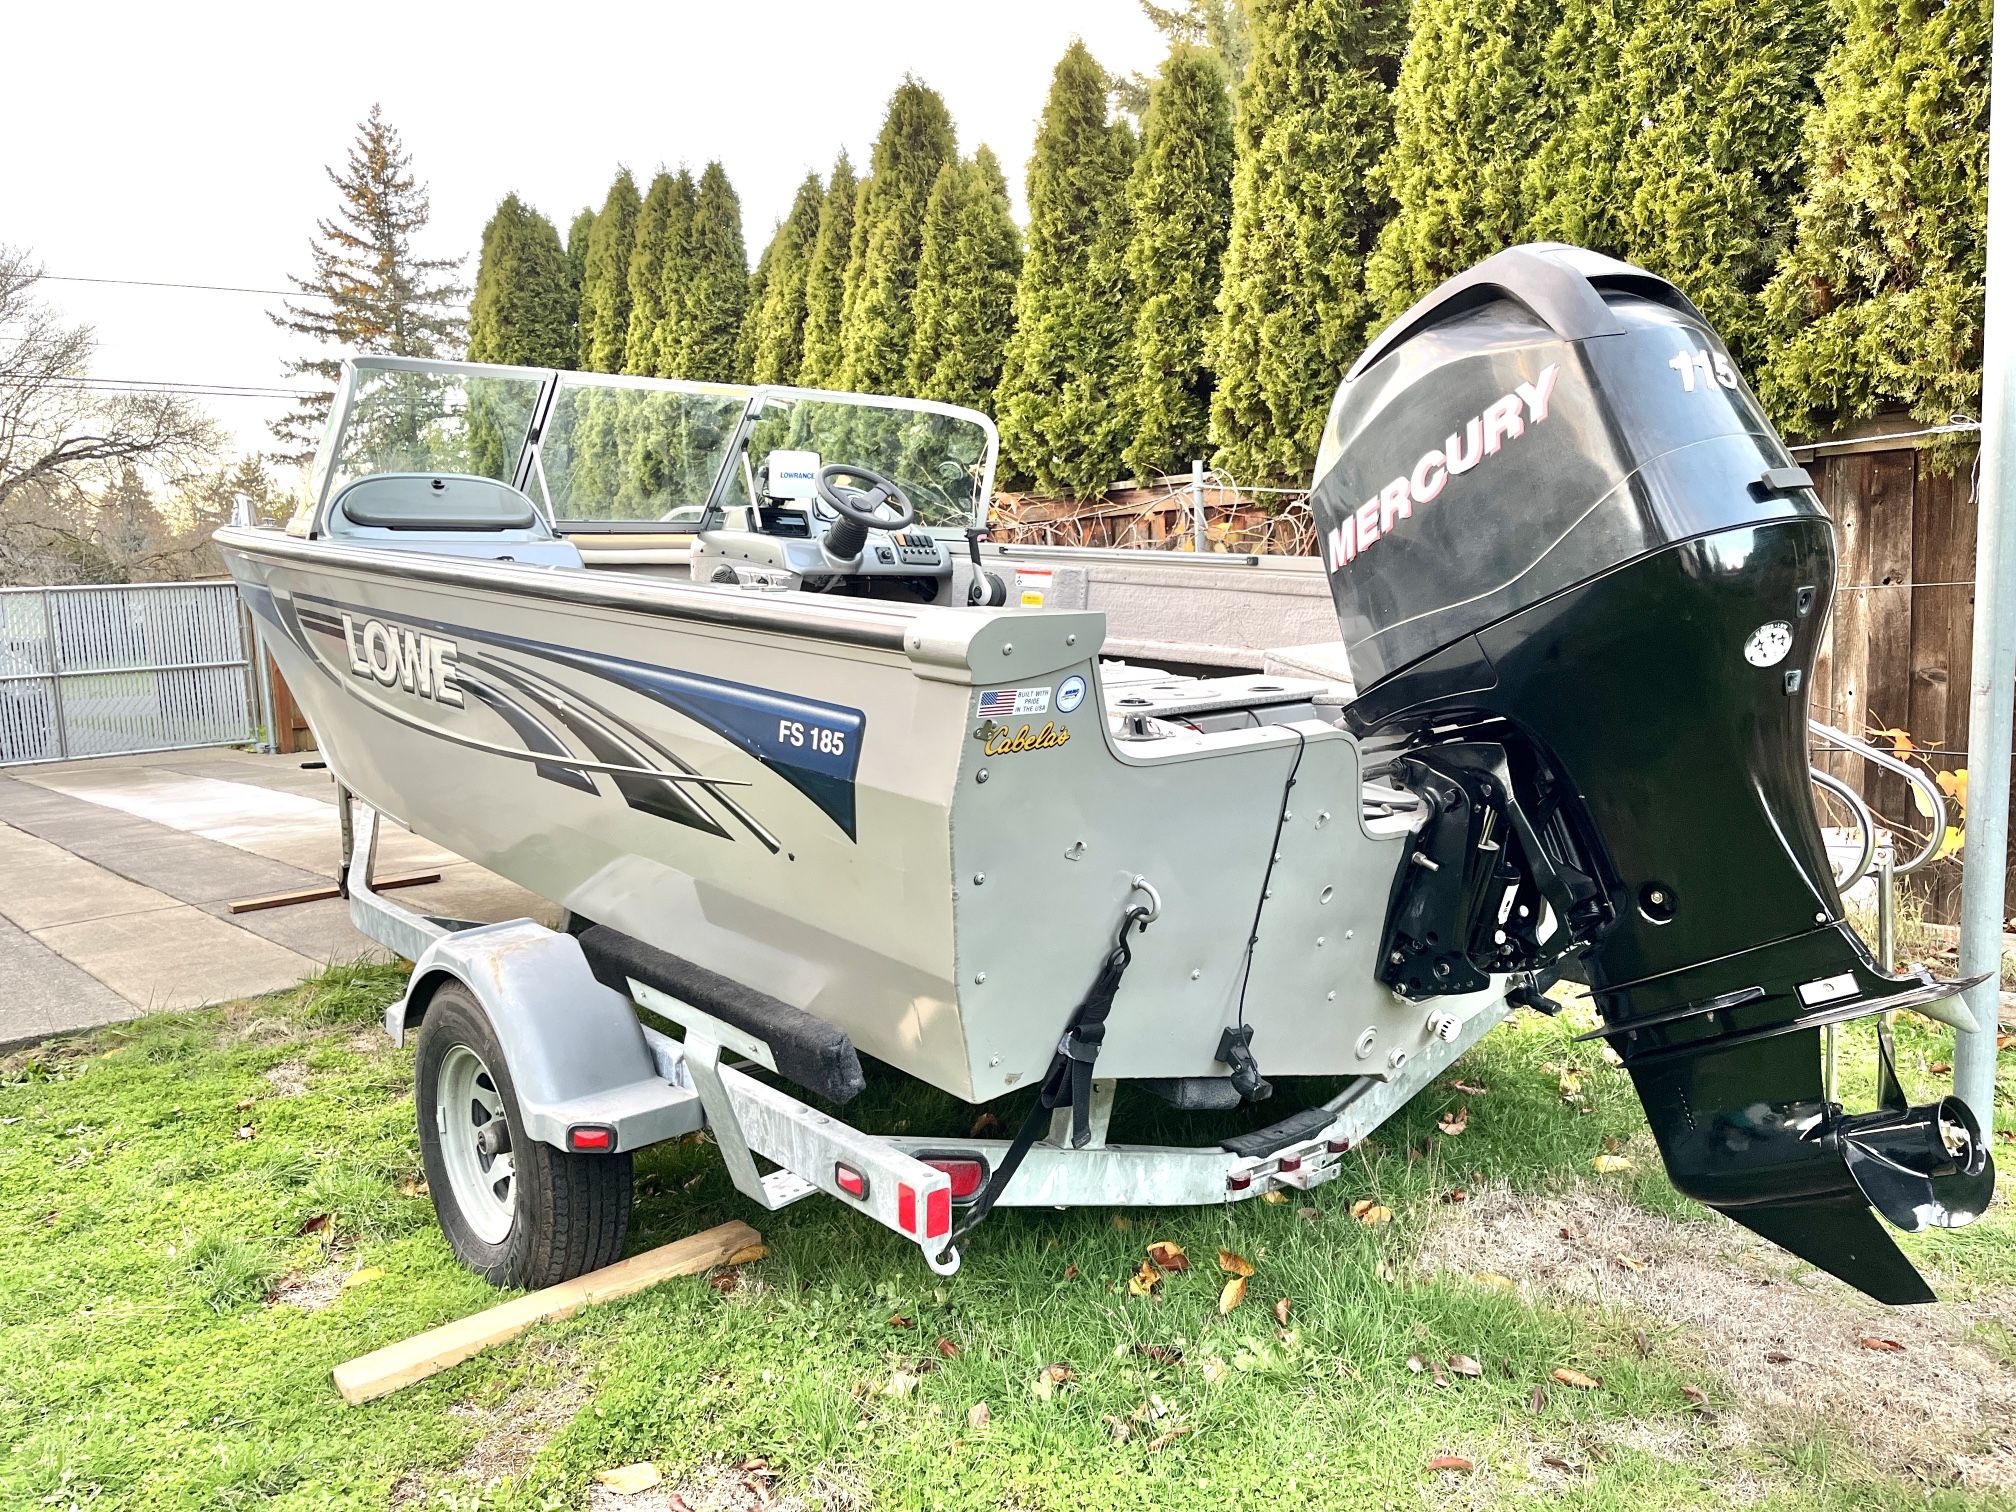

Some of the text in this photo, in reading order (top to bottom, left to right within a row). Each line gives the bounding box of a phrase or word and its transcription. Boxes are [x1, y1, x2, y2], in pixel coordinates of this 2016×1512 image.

[1668, 349, 1738, 392] 115
[780, 471, 816, 480] LOWRANCE
[1328, 362, 1560, 574] MERCURY
[341, 612, 465, 710] LOWE
[778, 719, 845, 756] FS 185
[984, 720, 1071, 757] Cabela's
